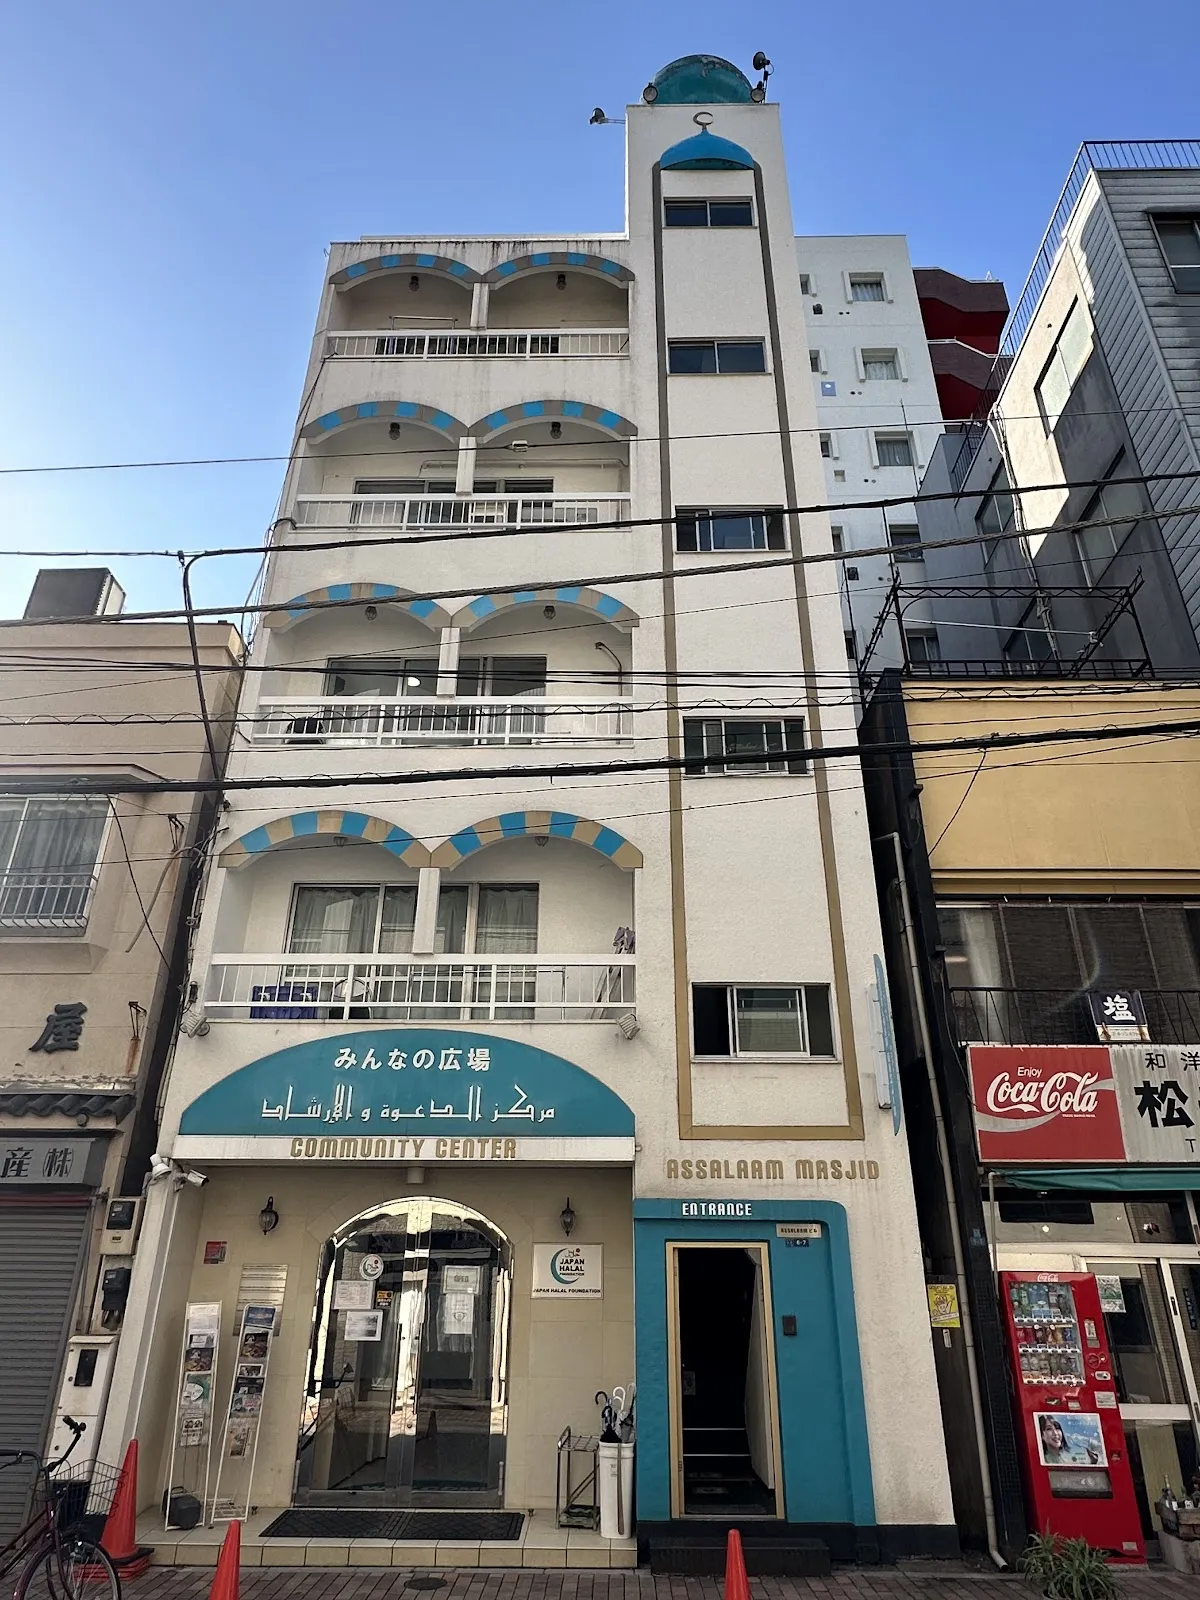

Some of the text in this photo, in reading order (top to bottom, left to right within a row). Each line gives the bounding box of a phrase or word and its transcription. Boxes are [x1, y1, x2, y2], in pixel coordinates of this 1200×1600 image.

[1103, 994, 1136, 1022] 塩
[28, 1001, 88, 1054] 屋
[334, 1048, 491, 1072] みんなの広場
[1017, 1066, 1042, 1079] Enjoy
[491, 1083, 555, 1123] مركز
[986, 1072, 1099, 1113] Coca-Cola
[1134, 1080, 1200, 1129] 松
[290, 1138, 517, 1158] COMMUNITY CENTER
[666, 1159, 880, 1180] ASSALAAM MASJID
[682, 1202, 752, 1217] ENTRANCE
